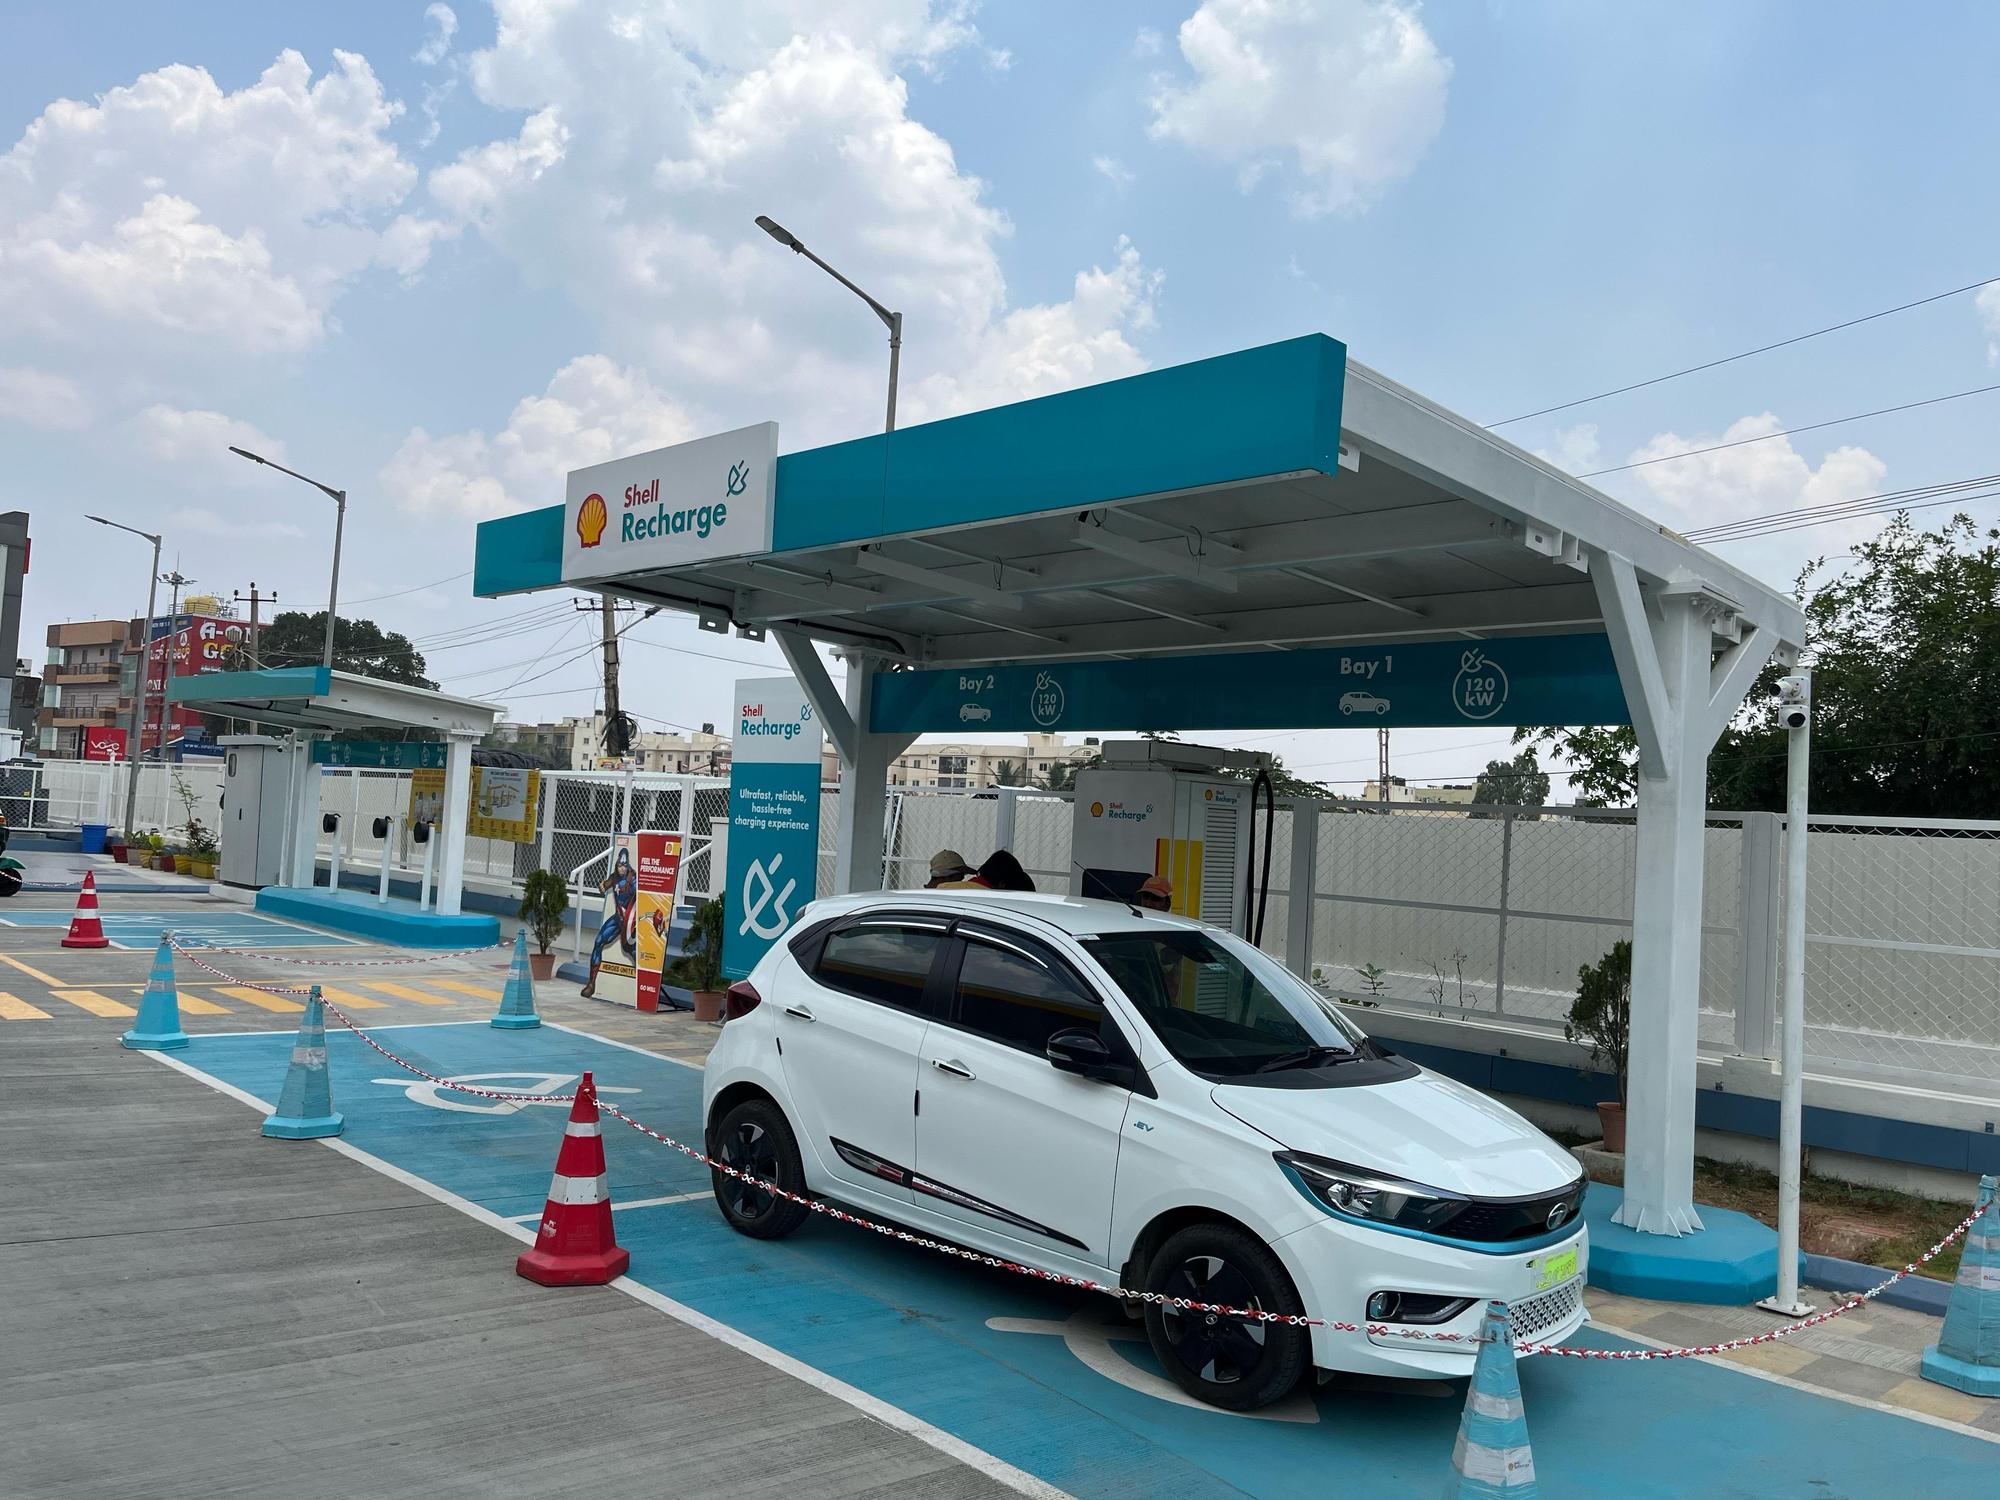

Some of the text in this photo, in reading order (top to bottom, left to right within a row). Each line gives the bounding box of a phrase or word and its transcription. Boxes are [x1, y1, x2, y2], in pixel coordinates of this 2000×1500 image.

[624, 479, 660, 508] Shell
[622, 503, 727, 542] Recharge
[1340, 656, 1392, 679] Bay 1
[960, 675, 994, 693] Bay 2
[1466, 678, 1496, 691] 120
[1039, 694, 1057, 704] 120
[1465, 691, 1495, 706] kW
[742, 704, 763, 717] Shell
[1038, 704, 1056, 715] kW
[741, 718, 801, 740] Recharge
[740, 788, 807, 804] Ultrafast, reliable,
[1216, 796, 1237, 804] Recharge
[751, 802, 792, 815] hassle-free
[1108, 810, 1147, 822] Recharge
[735, 815, 809, 831] charging experience
[641, 857, 661, 866] FEEL THE
[640, 865, 675, 875] PERFORMANCE
[602, 962, 620, 973] HEROES
